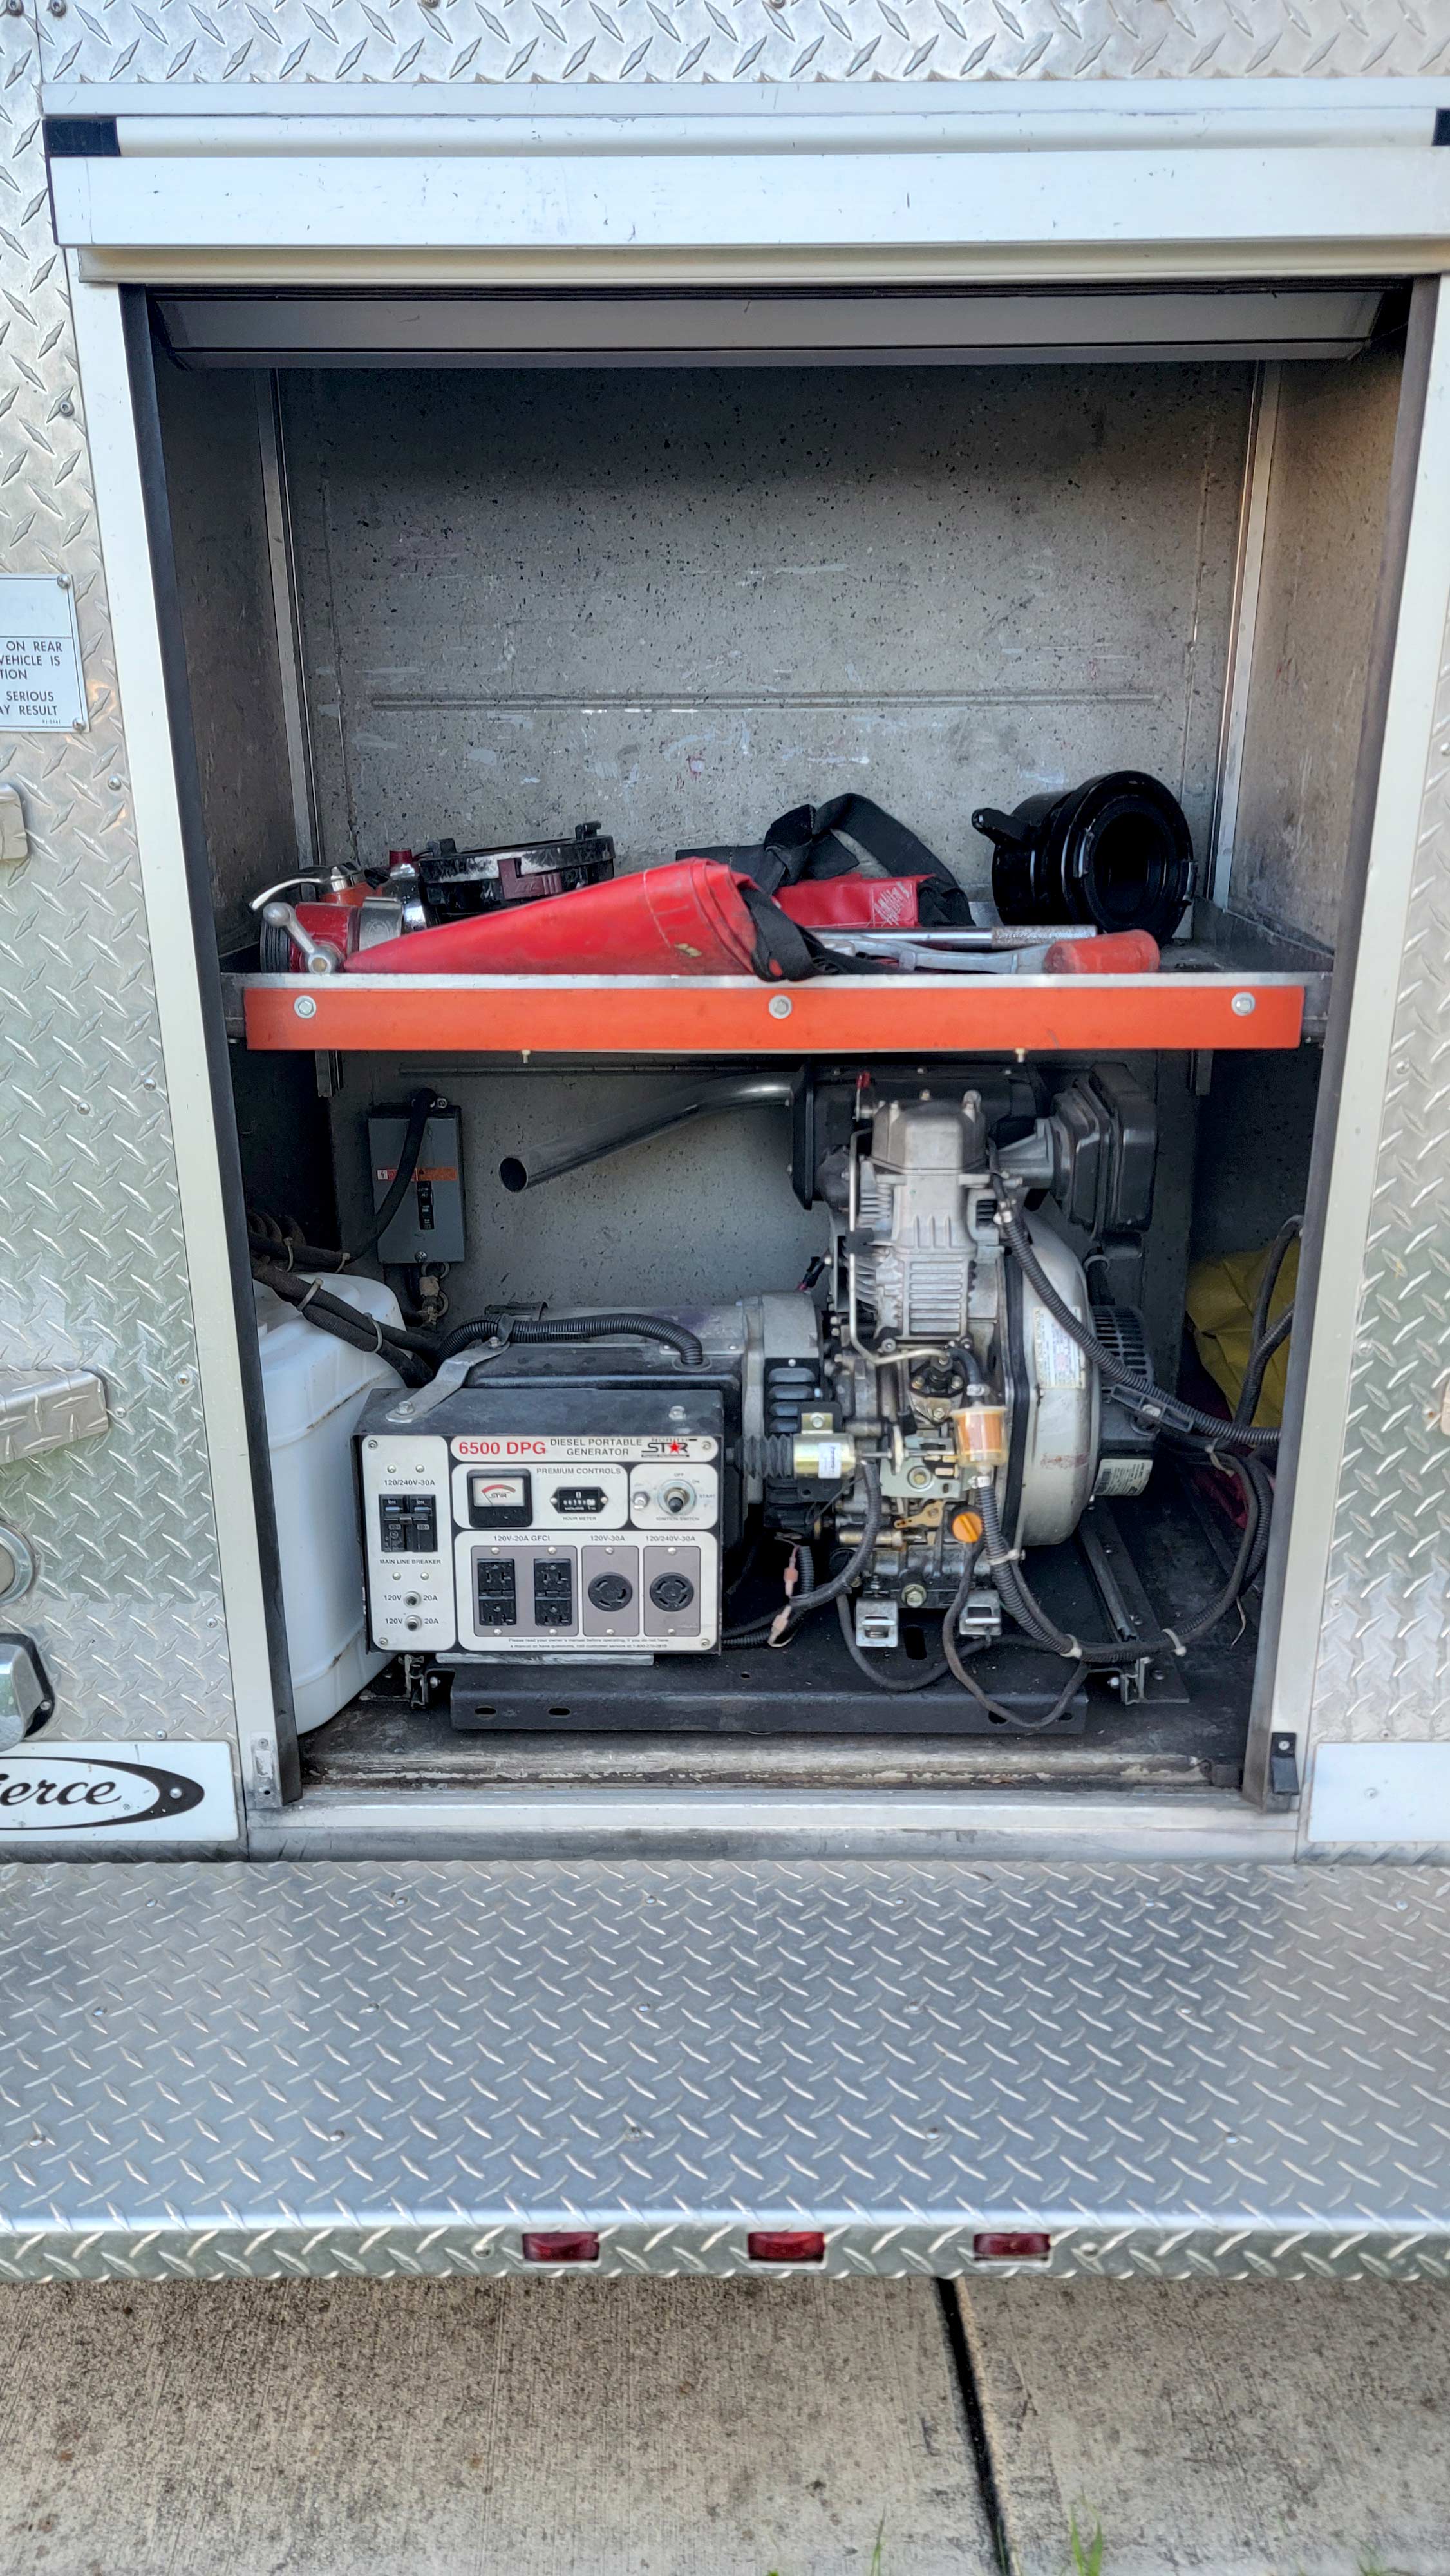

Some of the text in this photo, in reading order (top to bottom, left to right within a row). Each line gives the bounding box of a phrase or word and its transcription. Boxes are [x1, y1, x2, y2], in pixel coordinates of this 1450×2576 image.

[6, 641, 62, 652] ON REAR
[50, 656, 61, 666] IS
[6, 690, 54, 702] SERIOUS
[19, 705, 57, 715] RESULT
[551, 1438, 642, 1446] DIESEL PORTABLE
[459, 1441, 546, 1455] 6500 DPG
[567, 1448, 629, 1456] GENERATOR
